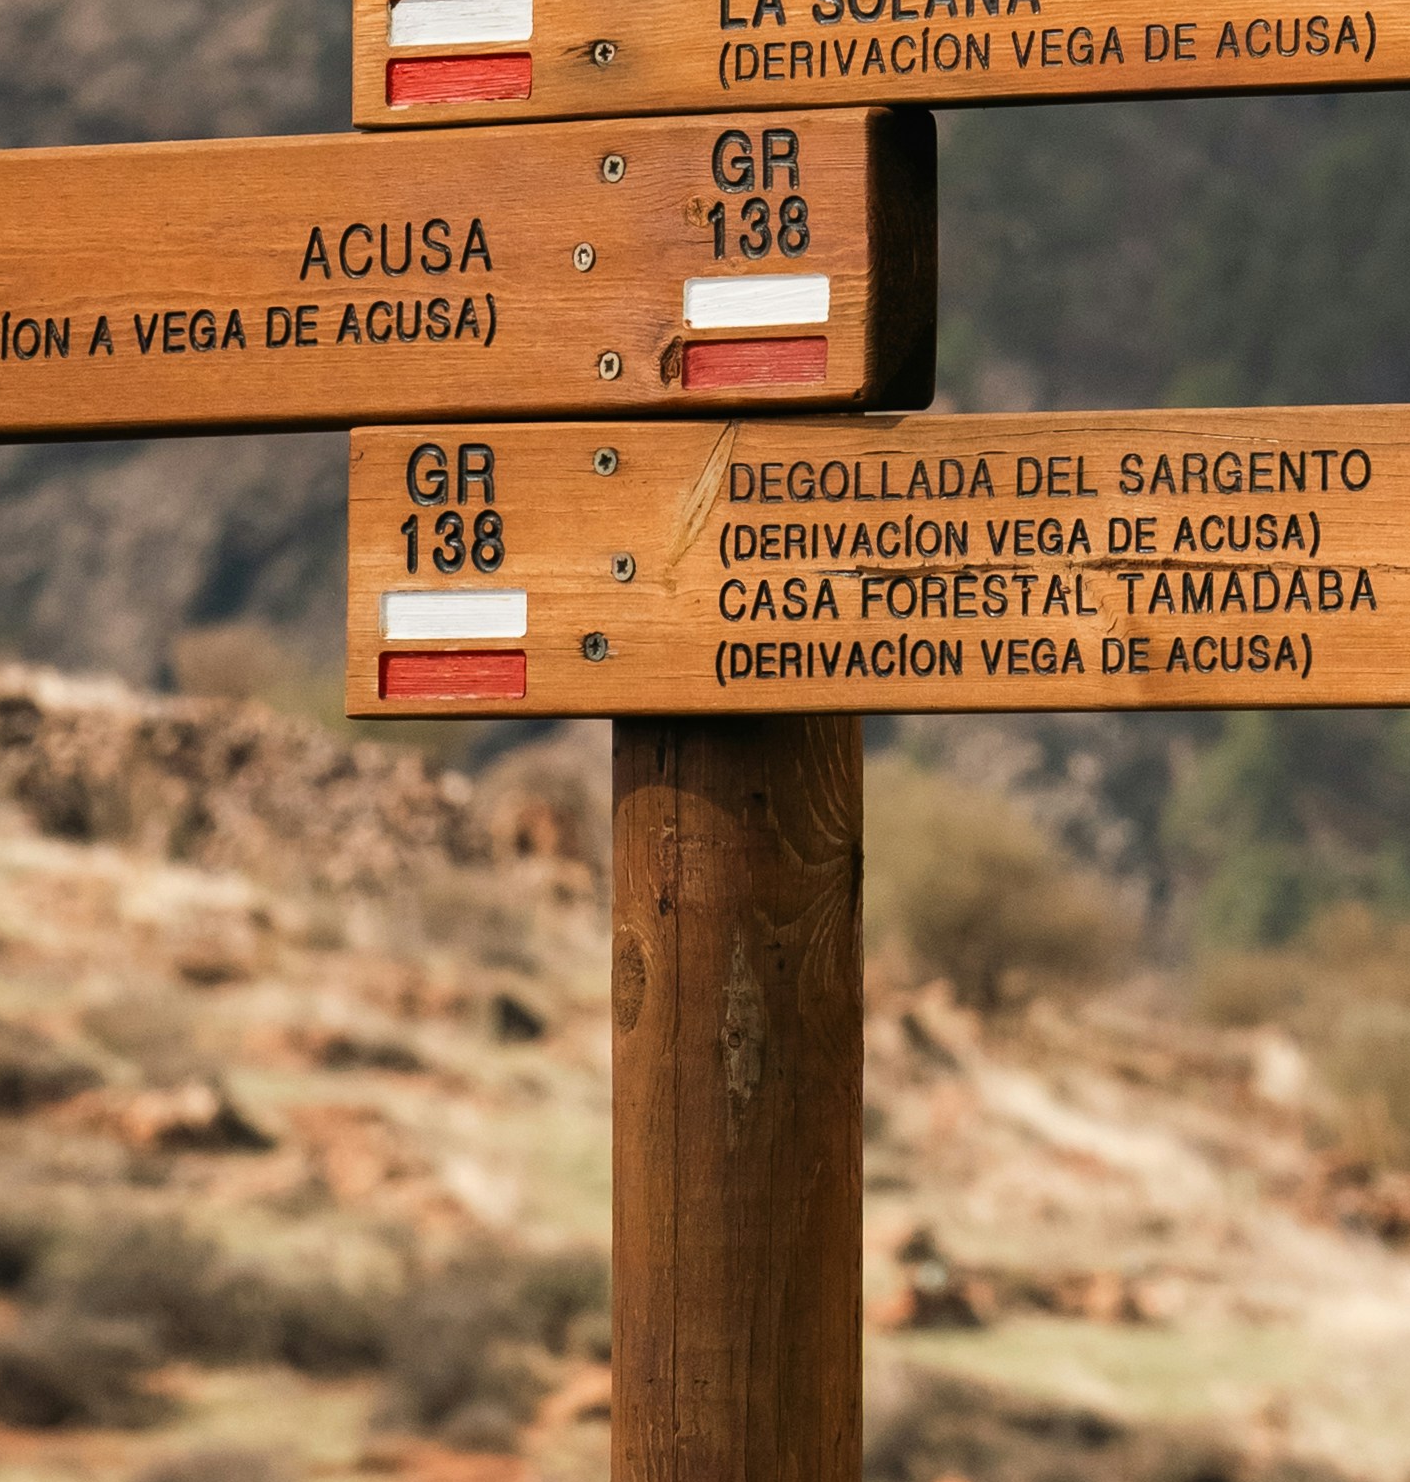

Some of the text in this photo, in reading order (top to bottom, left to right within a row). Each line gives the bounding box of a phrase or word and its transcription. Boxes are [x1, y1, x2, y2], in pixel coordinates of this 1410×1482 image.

[1011, 25, 1125, 69] VEGA
[1145, 22, 1198, 63] DE
[1216, 10, 1377, 63] ACUSA)
[711, 127, 800, 194] GR
[299, 218, 493, 282] ACUSA
[707, 195, 811, 260] 138
[89, 315, 115, 357] A
[134, 308, 247, 356] VEGA
[265, 304, 320, 350] DE
[336, 292, 497, 348] ACUSA)
[406, 443, 495, 507] GR
[729, 448, 1372, 504] DEGOLLADA DEL SARGENTO
[400, 509, 505, 574] 138
[985, 517, 1091, 556] VEGA
[1108, 516, 1157, 554] DE
[1173, 511, 1321, 558] ACUSA)
[719, 568, 1377, 622] CASA FORESTAL TAMADABA
[980, 637, 1085, 676] VEGA
[1102, 637, 1150, 675] DE
[1166, 632, 1313, 680] ACUSA)
